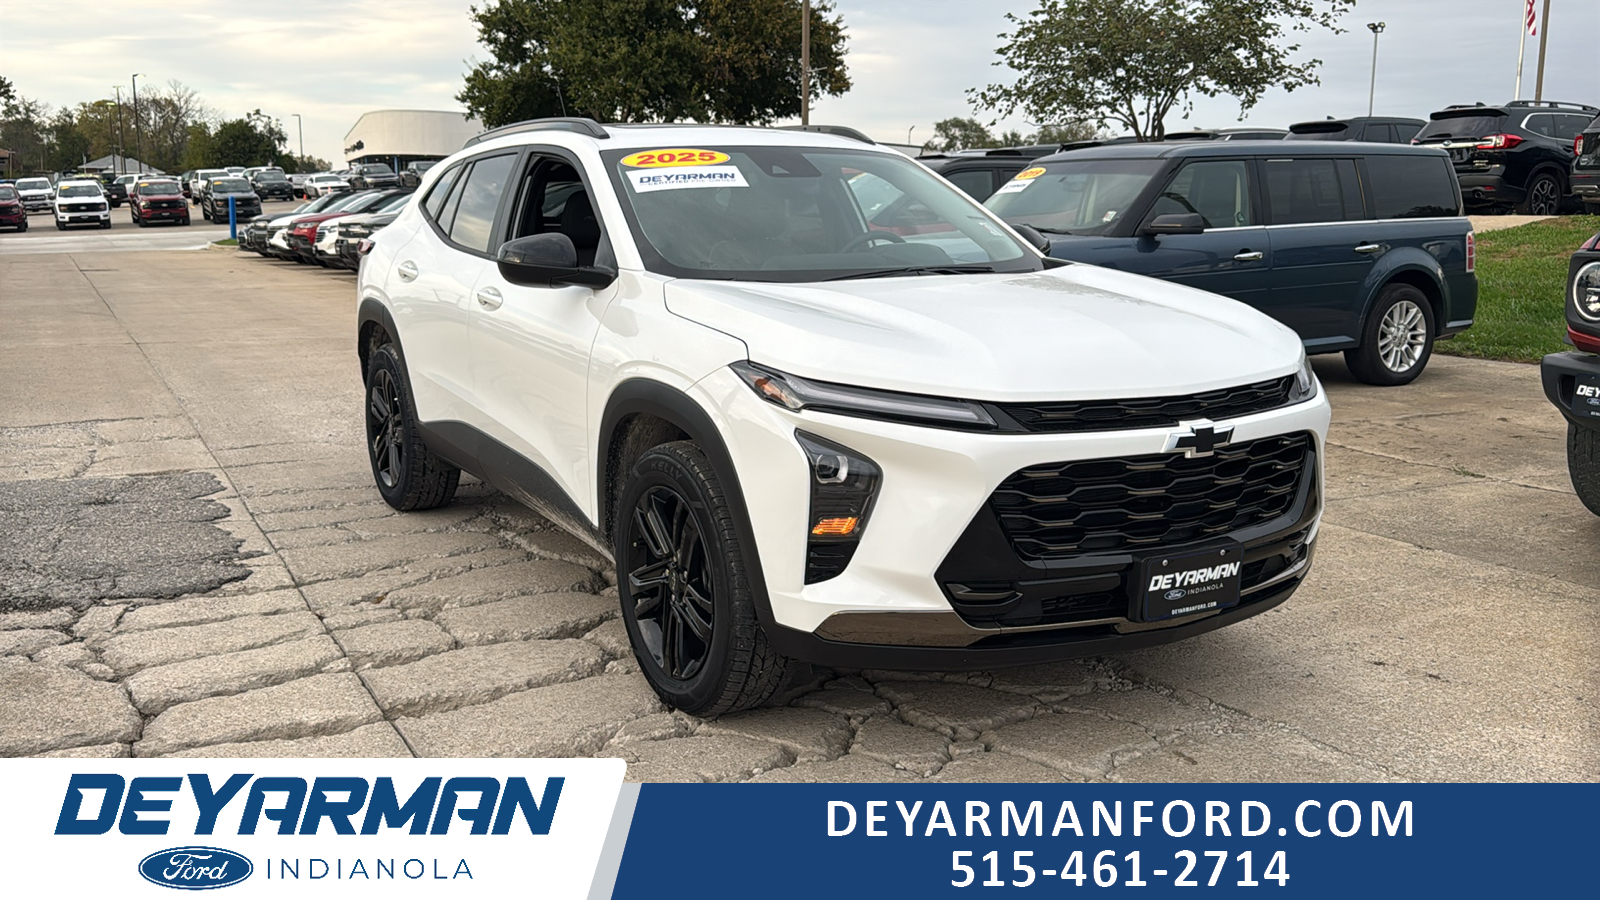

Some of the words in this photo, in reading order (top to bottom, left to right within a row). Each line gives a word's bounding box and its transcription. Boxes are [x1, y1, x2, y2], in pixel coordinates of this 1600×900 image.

[636, 152, 717, 166] 2025
[639, 173, 735, 184] DEYARMAN
[651, 460, 683, 480] KELLY
[1148, 561, 1241, 592] DEYARMAN
[1187, 582, 1224, 595] INDIANOLA
[1171, 601, 1217, 615] DEYARMANFORD.COM
